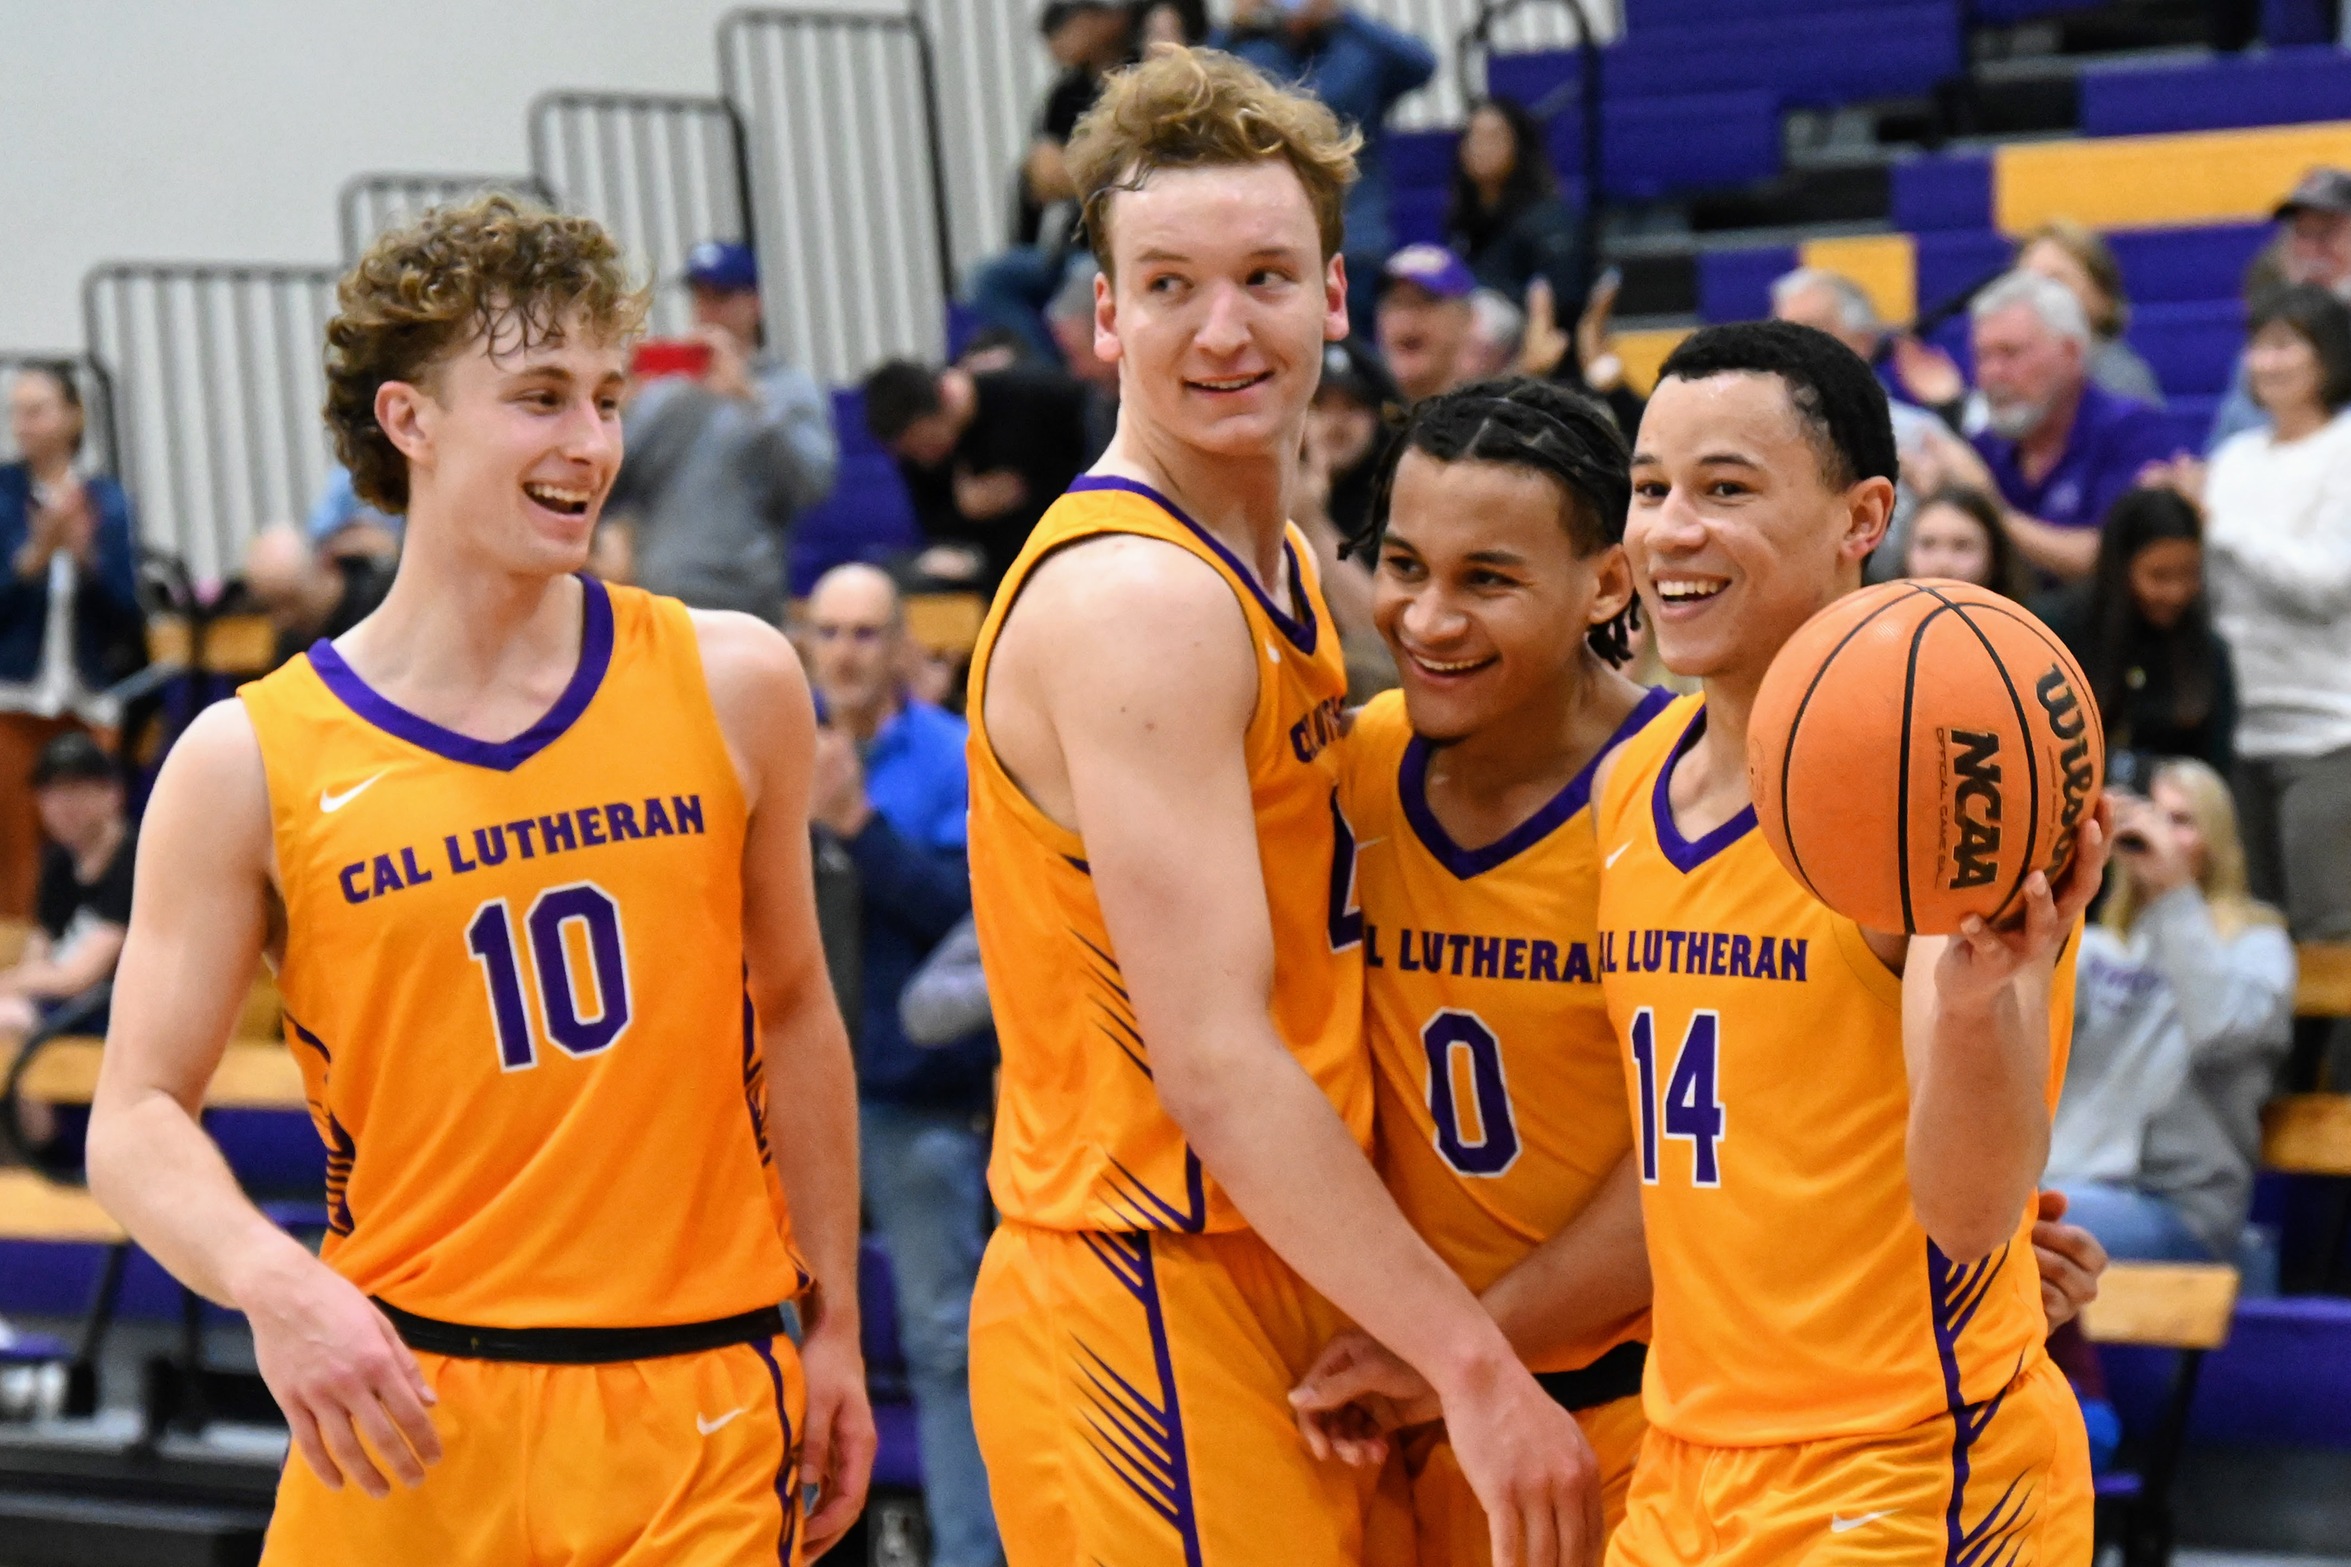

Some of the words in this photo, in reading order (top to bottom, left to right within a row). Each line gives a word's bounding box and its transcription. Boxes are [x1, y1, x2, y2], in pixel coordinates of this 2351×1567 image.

[338, 847, 432, 904] CAL
[444, 795, 706, 874] LUTHERAN
[1949, 729, 2002, 890] NCAA
[2036, 662, 2094, 878] Wilso
[464, 880, 632, 1073] 10
[1400, 928, 1602, 984] LUTHERA
[1627, 929, 1808, 982] LUTHERAN
[1419, 1007, 1523, 1178] 0
[1629, 1006, 1726, 1189] 14
